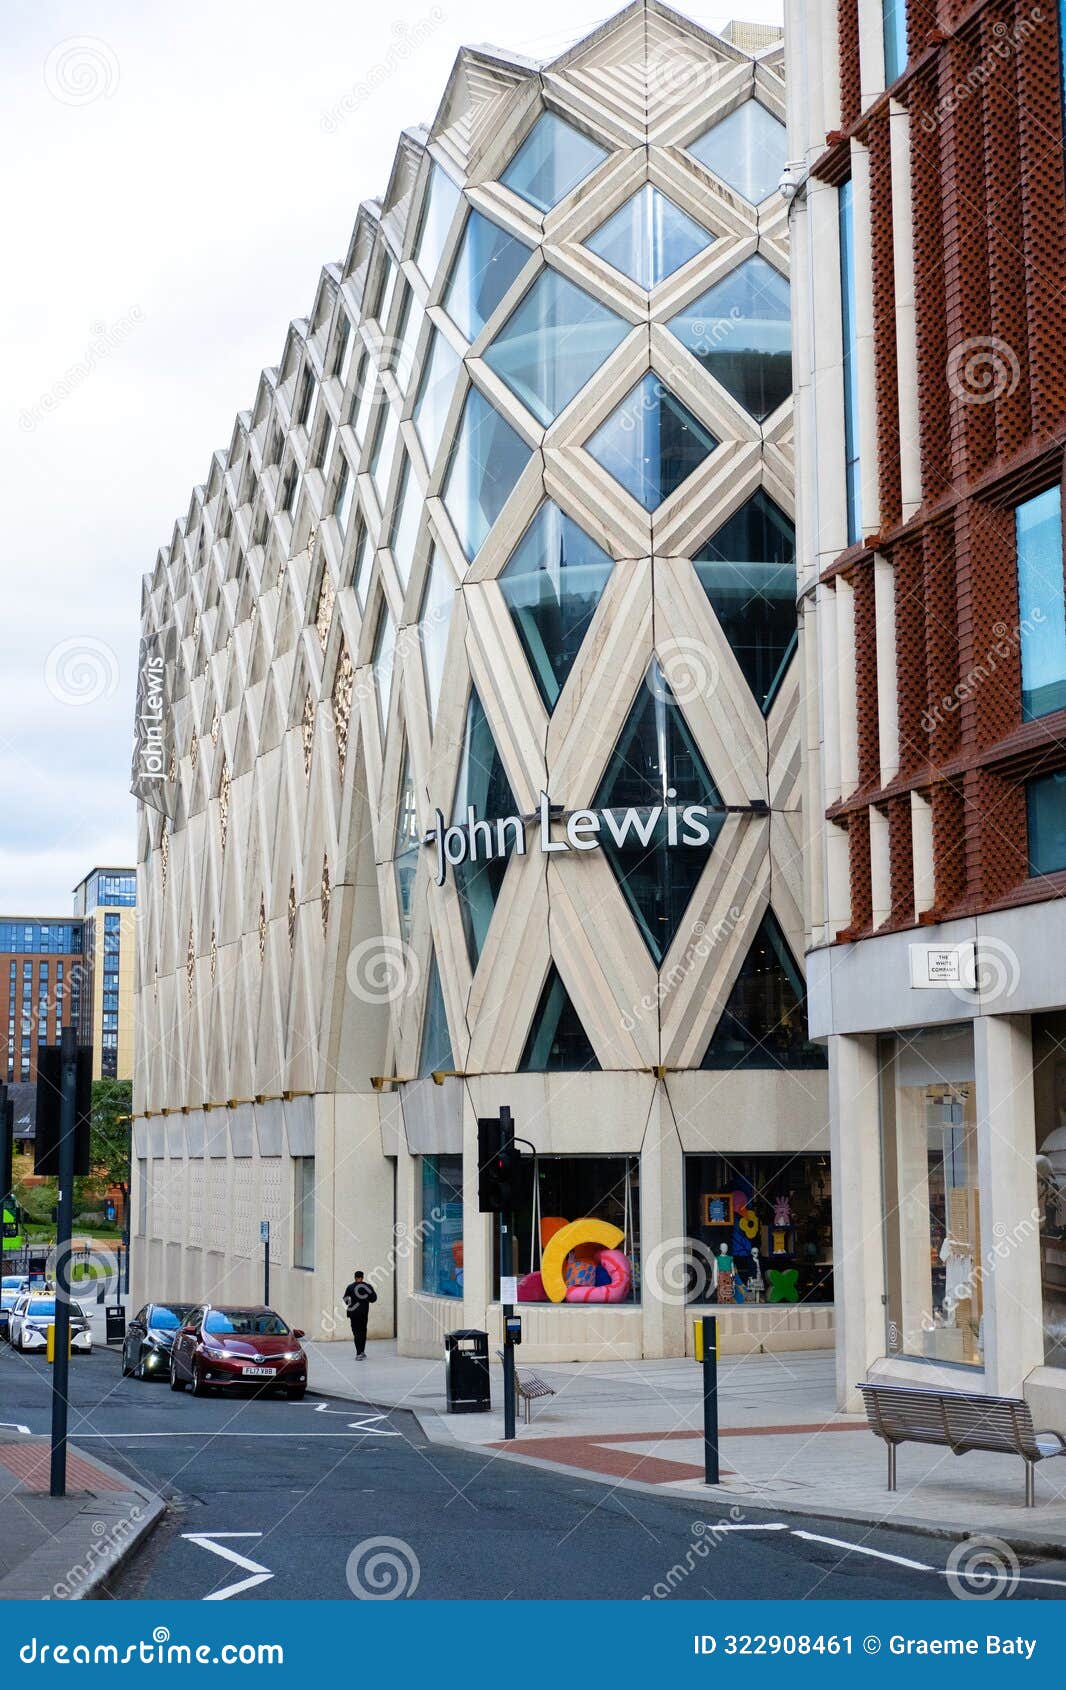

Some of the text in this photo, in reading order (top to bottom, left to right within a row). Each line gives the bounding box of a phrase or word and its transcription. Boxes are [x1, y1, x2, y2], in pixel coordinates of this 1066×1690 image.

[138, 656, 168, 781] John Lewis
[434, 788, 710, 887] John Lewis
